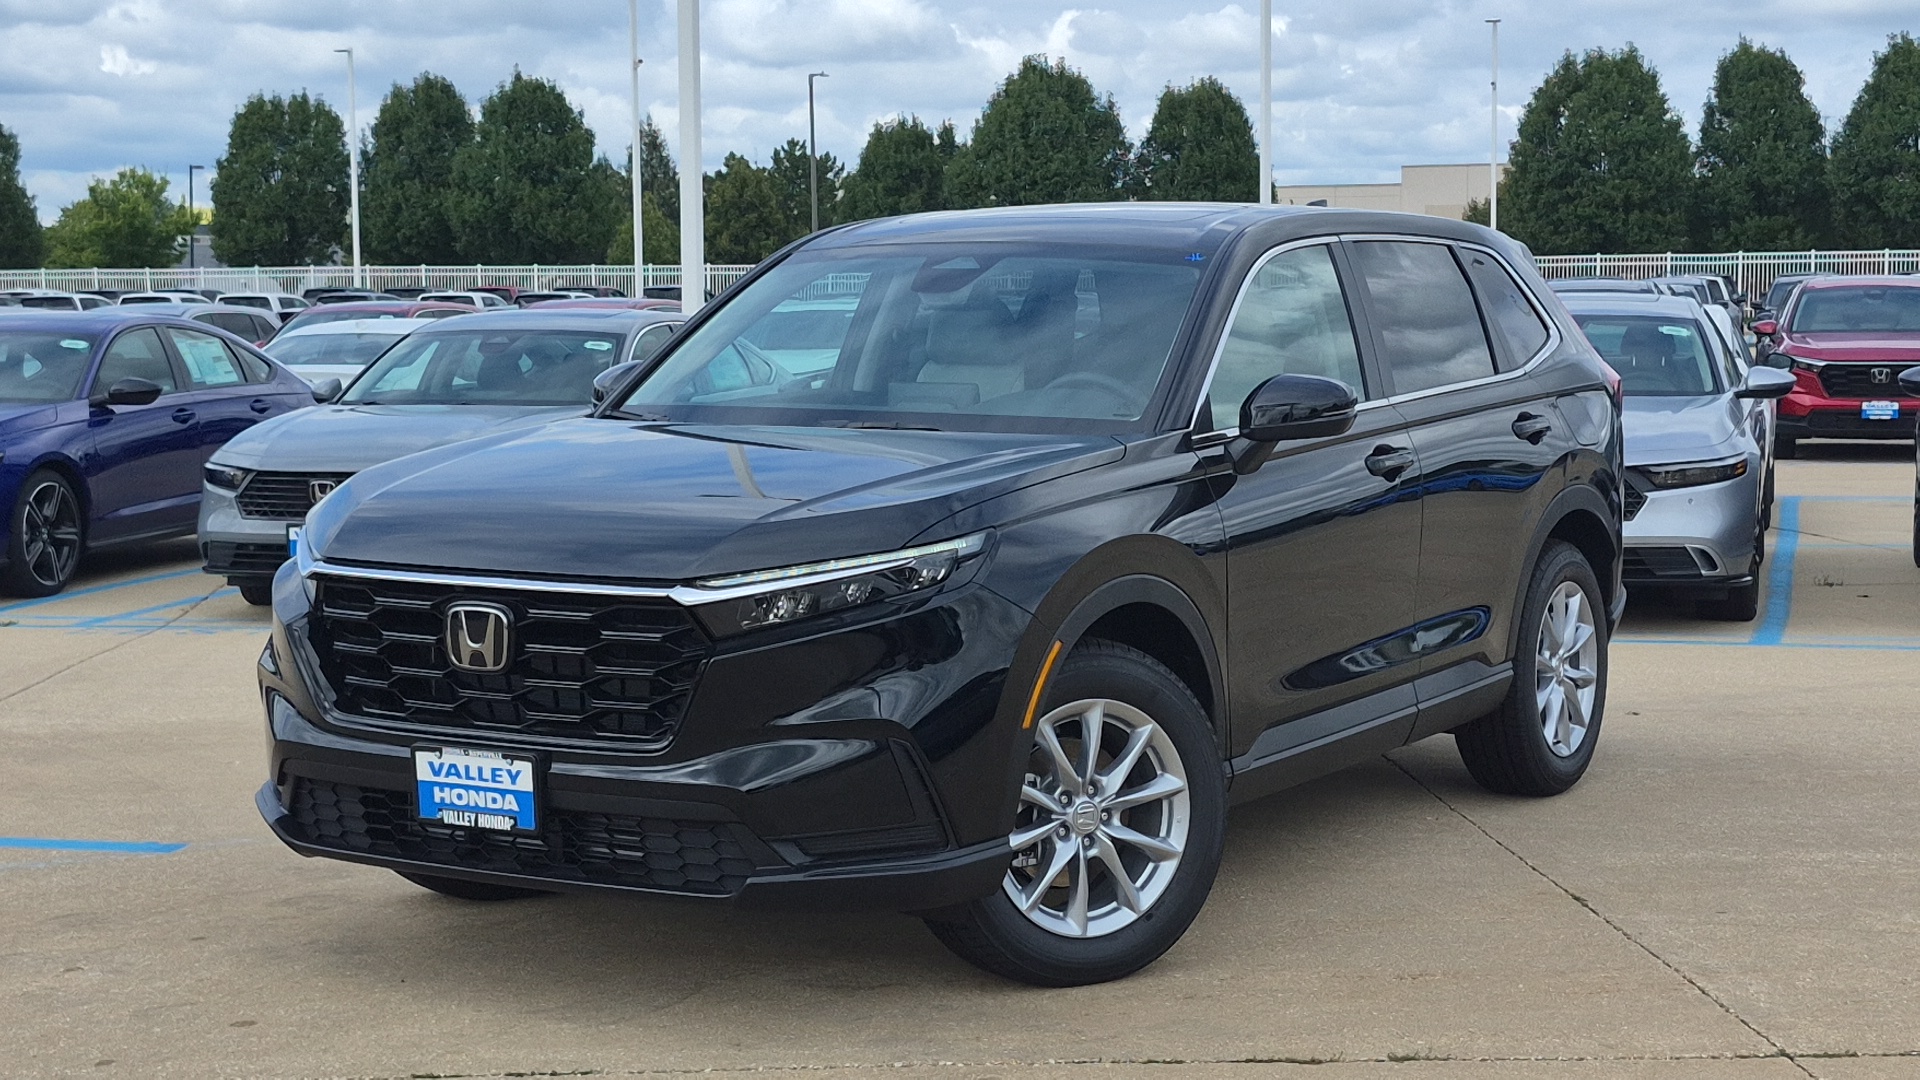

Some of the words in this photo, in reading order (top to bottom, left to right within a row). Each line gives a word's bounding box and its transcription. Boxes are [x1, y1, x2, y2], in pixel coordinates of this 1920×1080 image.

[427, 761, 522, 785] VALLEY
[433, 786, 520, 812] HONDA
[442, 810, 476, 827] VALLEY
[477, 814, 513, 831] HONDA
